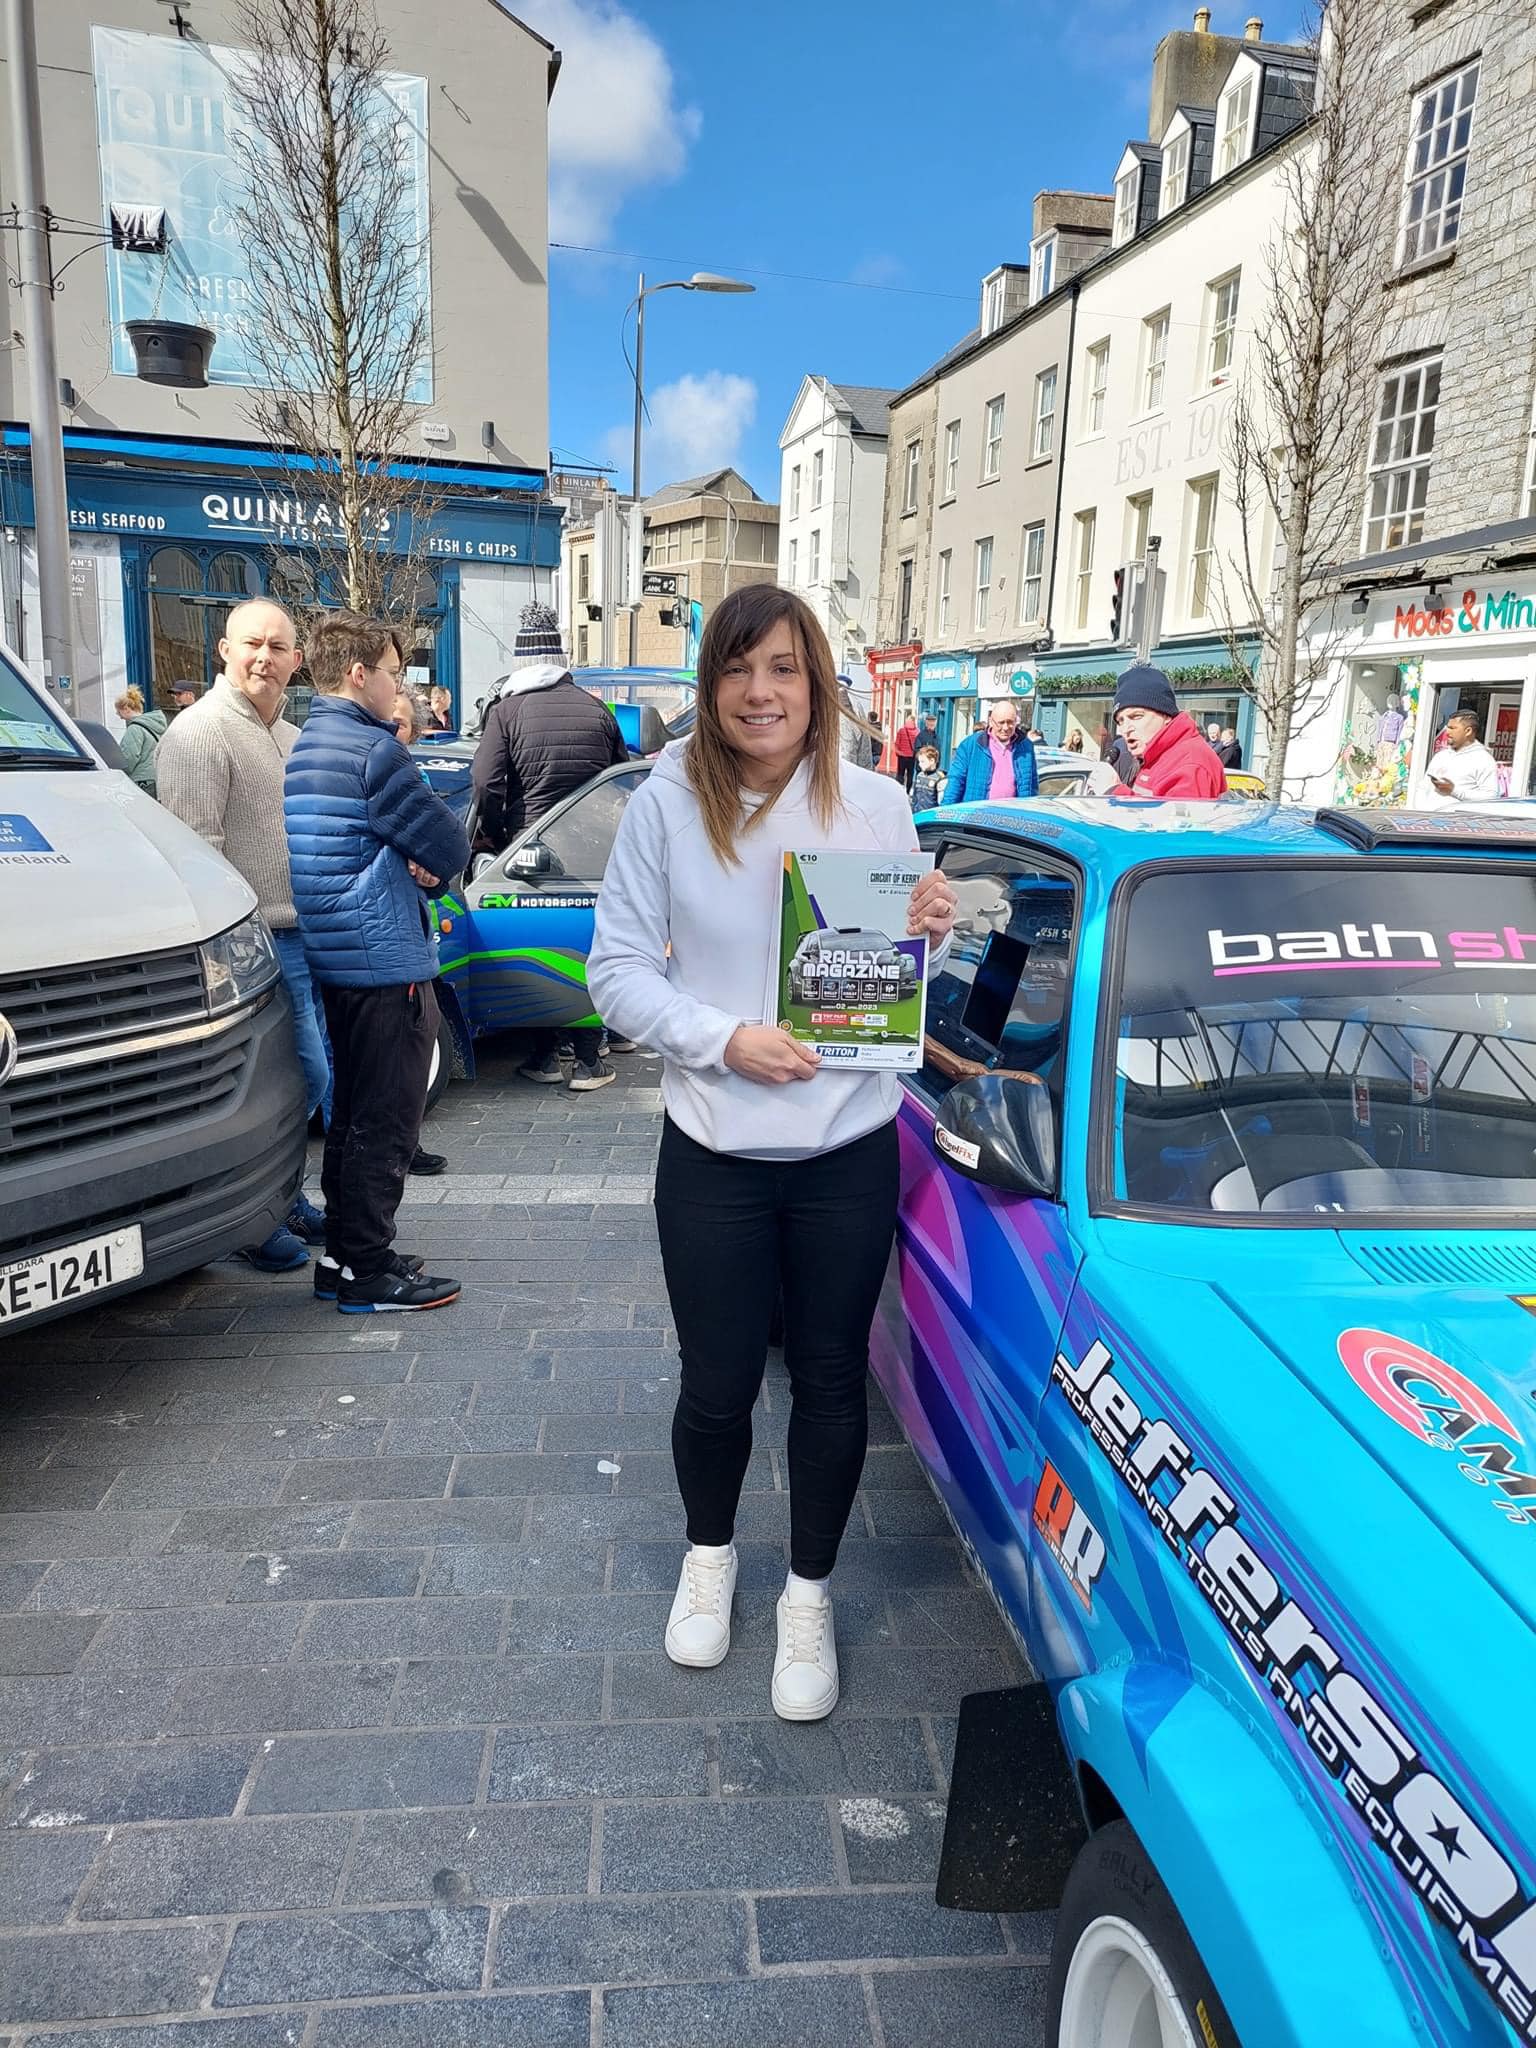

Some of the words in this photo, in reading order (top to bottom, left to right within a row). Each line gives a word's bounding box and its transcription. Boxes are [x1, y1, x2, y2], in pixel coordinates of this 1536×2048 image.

[70, 511, 96, 525] ESH
[102, 513, 166, 530] SEAFOOD
[430, 538, 460, 553] FISH
[465, 541, 473, 554] &
[478, 542, 517, 557] CHIPS
[1458, 588, 1481, 632] &
[1485, 590, 1536, 631] Min
[1495, 732, 1515, 746] GRE
[800, 854, 817, 862] €10
[870, 873, 892, 883] CIRCUIT
[893, 873, 901, 883] OF
[902, 874, 921, 884] KERRY
[520, 898, 597, 908] MOTORSPORT
[1207, 923, 1439, 967] bath
[819, 950, 882, 965] RALLY
[803, 963, 900, 979] MAGAZINE
[820, 1047, 856, 1057] TRITON
[17, 1257, 45, 1271] DARA
[1056, 1339, 1536, 1995] Jefferso
[1052, 1364, 1179, 1547] PROFESSIONAL
[1187, 1544, 1266, 1663] TOOLS
[1269, 1665, 1339, 1763] AND
[1344, 1767, 1536, 2040] EQUIPME
